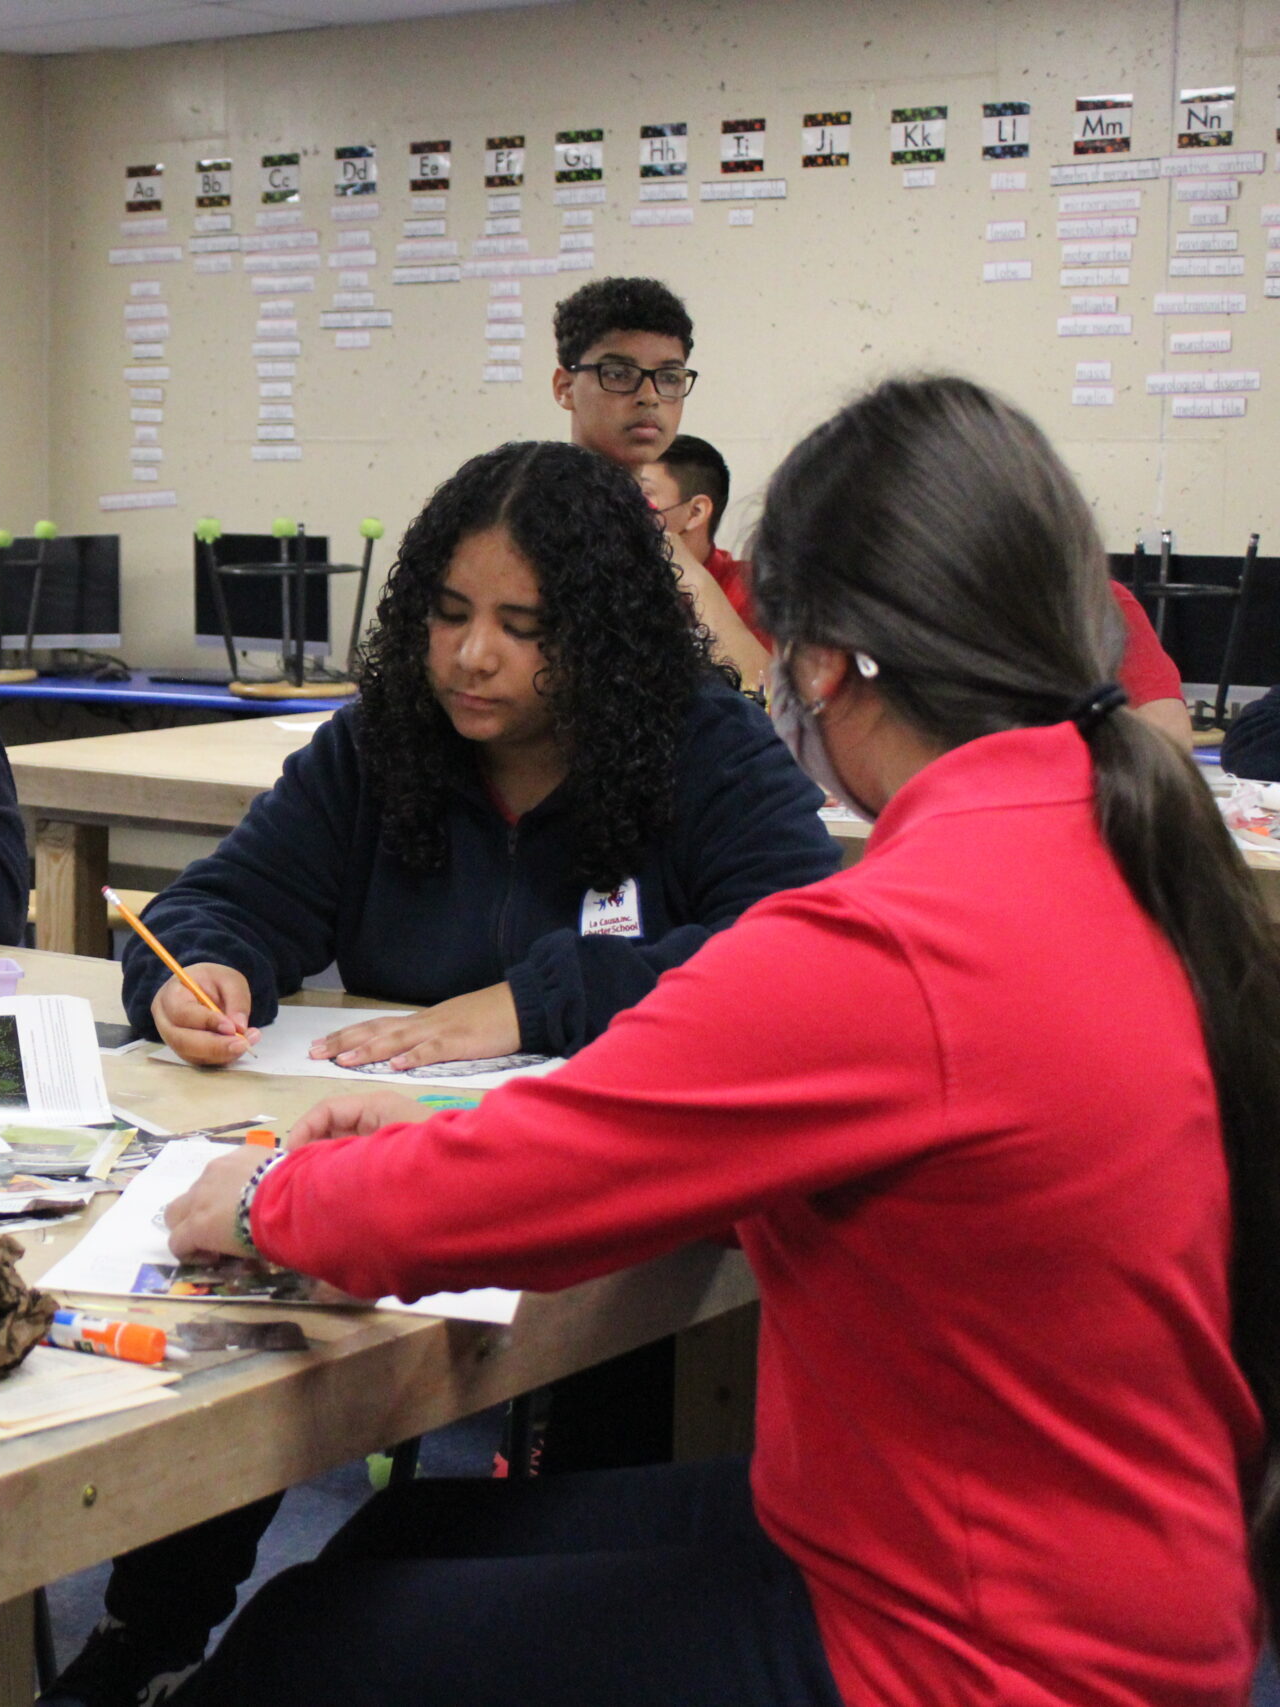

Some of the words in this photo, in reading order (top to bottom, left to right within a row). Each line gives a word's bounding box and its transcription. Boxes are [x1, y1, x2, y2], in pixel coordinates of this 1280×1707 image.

[1082, 116, 1123, 138] Mm
[1187, 105, 1221, 130] Nn
[815, 128, 834, 153] Jj
[904, 121, 932, 148] Kk
[649, 139, 676, 163] Hh
[732, 134, 750, 159] Ii
[420, 158, 440, 177] Ee
[495, 152, 513, 174] Ff
[565, 150, 594, 170] Gg
[269, 170, 291, 189] Cc
[342, 161, 368, 182] Dd
[133, 182, 156, 198] Aa
[202, 174, 222, 194] Bb
[611, 922, 638, 933] School
